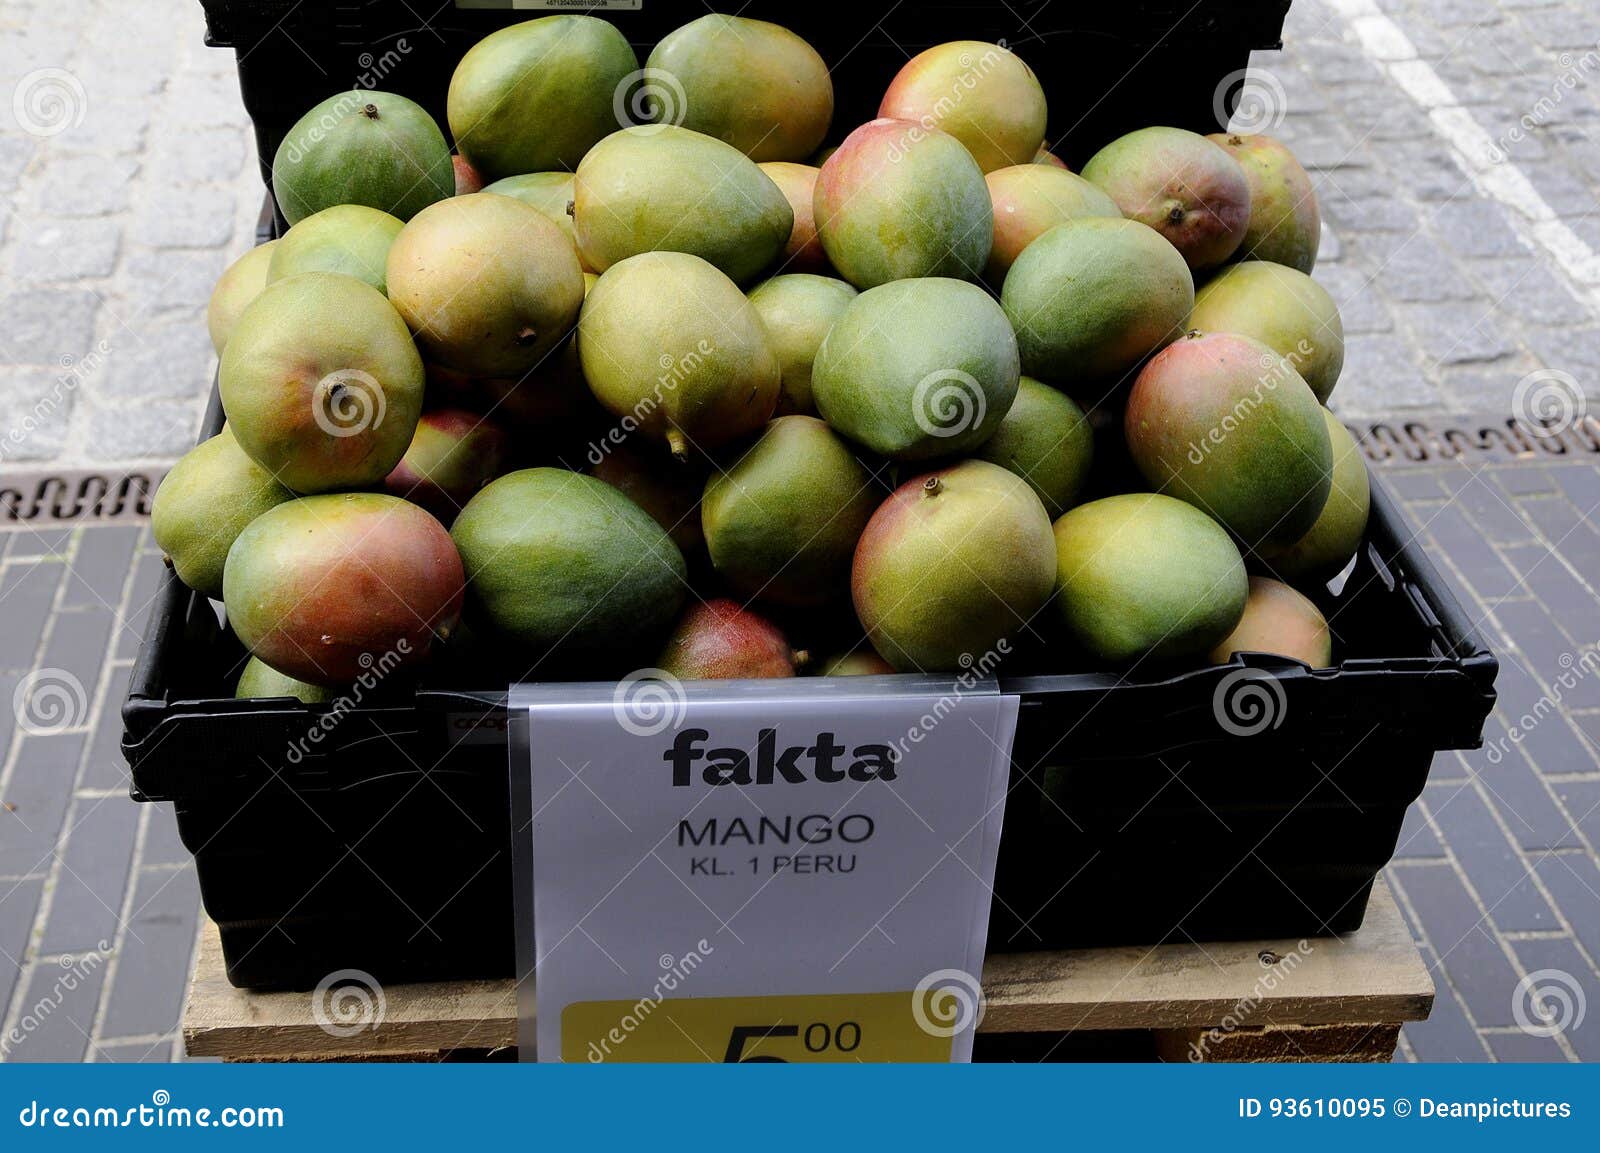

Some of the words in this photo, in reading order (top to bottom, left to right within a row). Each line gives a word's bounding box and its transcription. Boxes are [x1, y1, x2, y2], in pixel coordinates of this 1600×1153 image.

[662, 727, 899, 787] fakta
[677, 813, 876, 847] MANGO
[690, 856, 735, 876] KL.
[748, 856, 759, 875] 1
[772, 854, 857, 874] PERU
